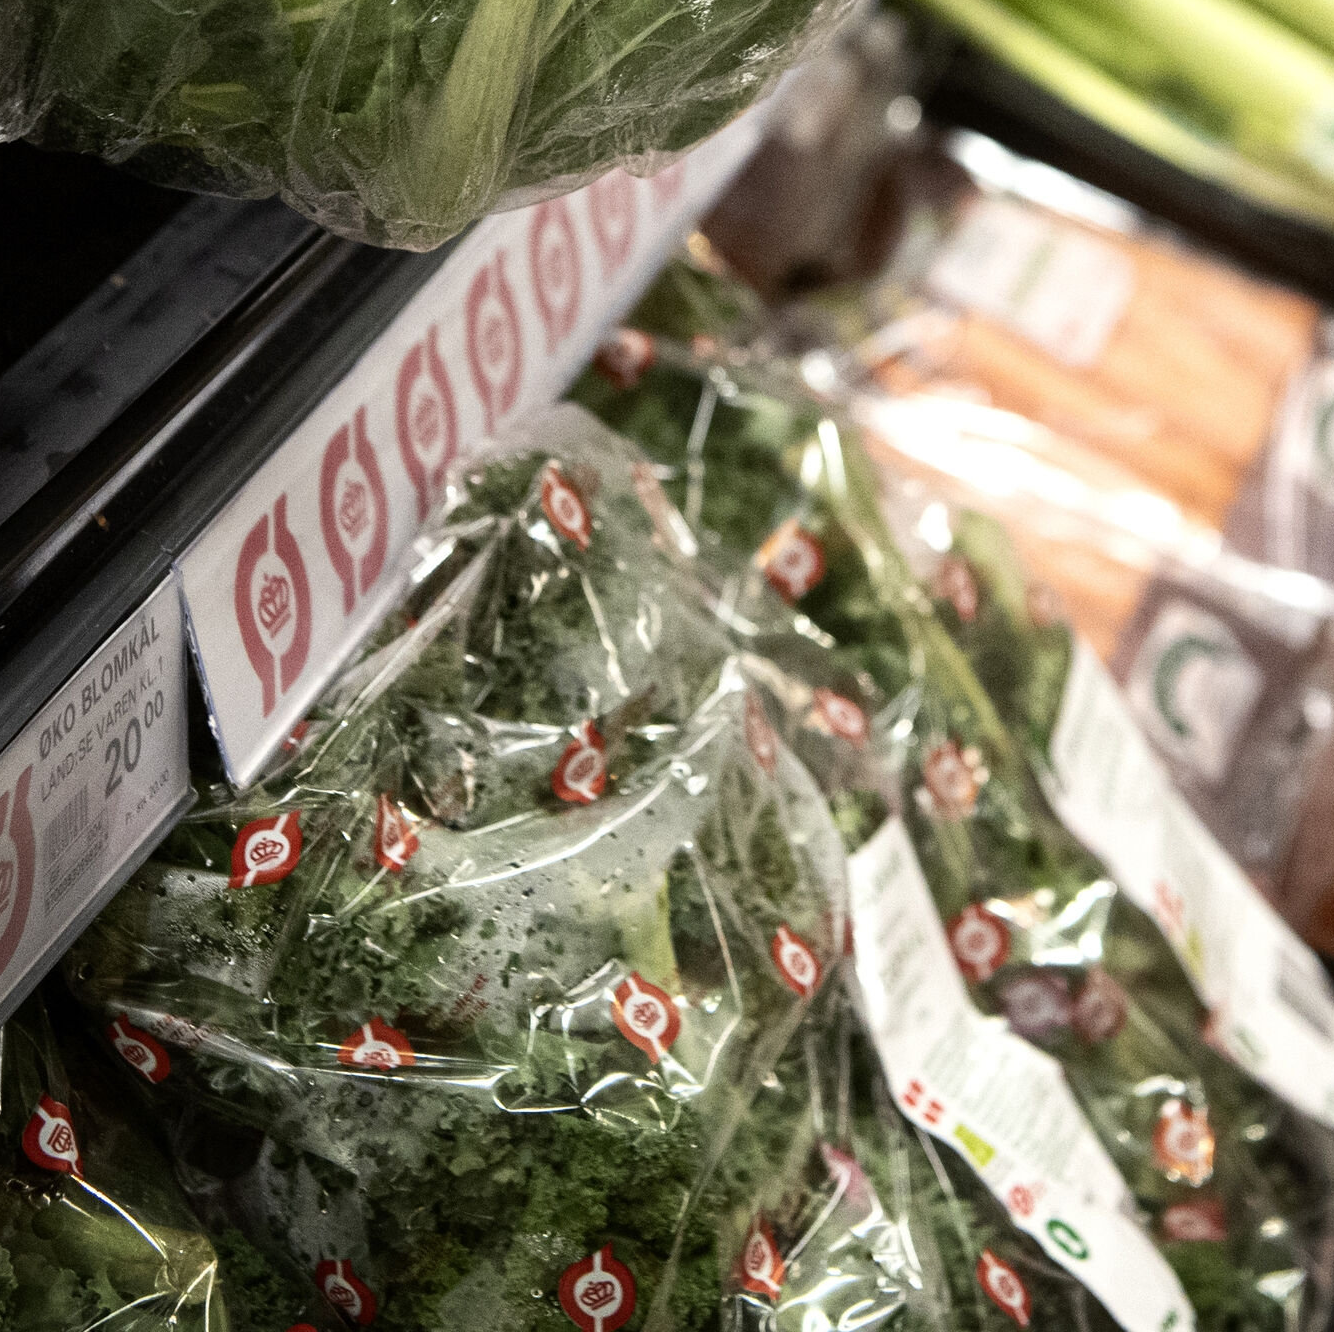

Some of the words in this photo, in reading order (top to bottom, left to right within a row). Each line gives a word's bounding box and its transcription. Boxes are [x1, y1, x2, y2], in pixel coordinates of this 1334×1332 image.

[39, 703, 75, 761] ØKO
[81, 614, 160, 715] BLOMKÅL
[96, 686, 137, 741] VAREN
